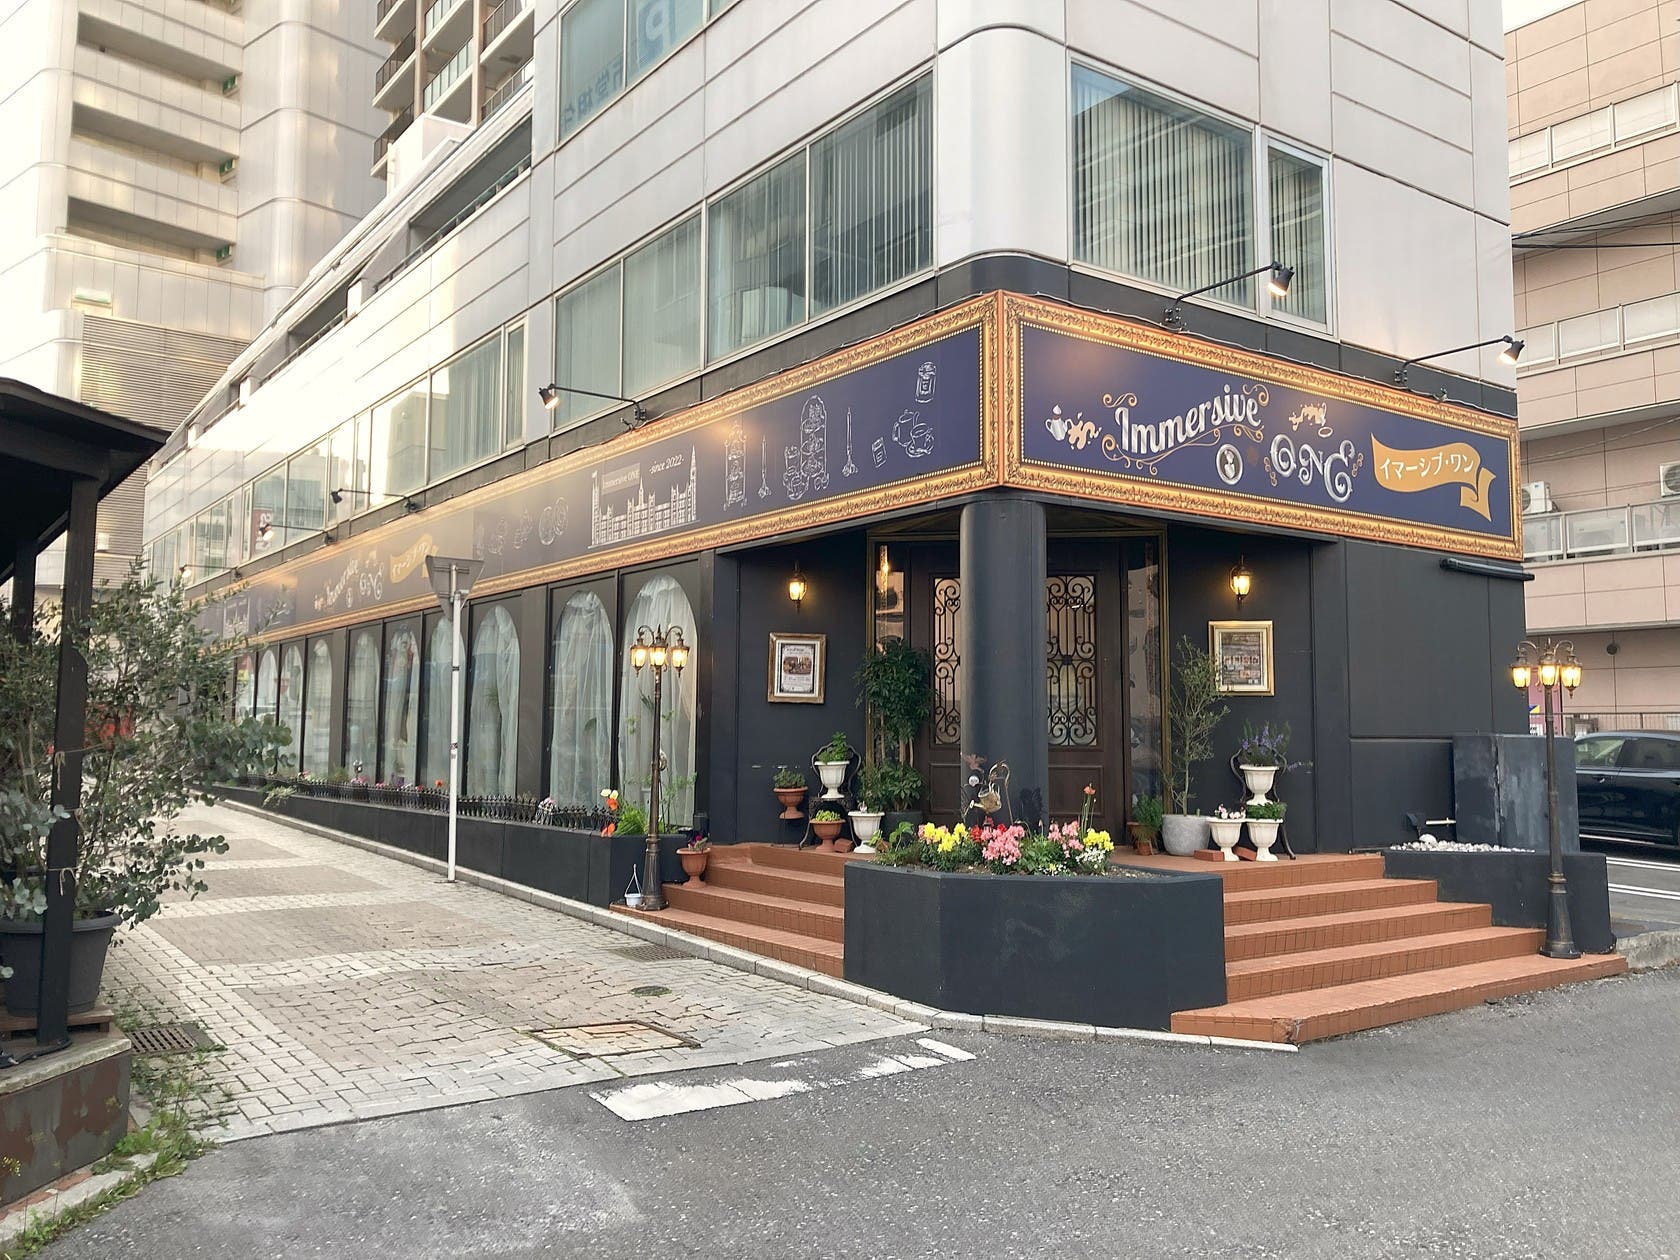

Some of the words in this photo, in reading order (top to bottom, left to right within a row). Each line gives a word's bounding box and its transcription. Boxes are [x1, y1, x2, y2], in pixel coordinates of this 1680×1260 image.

[1114, 384, 1262, 454] Immersive
[1270, 434, 1355, 502] ONE
[1380, 452, 1474, 480] イマーシブ・ワン
